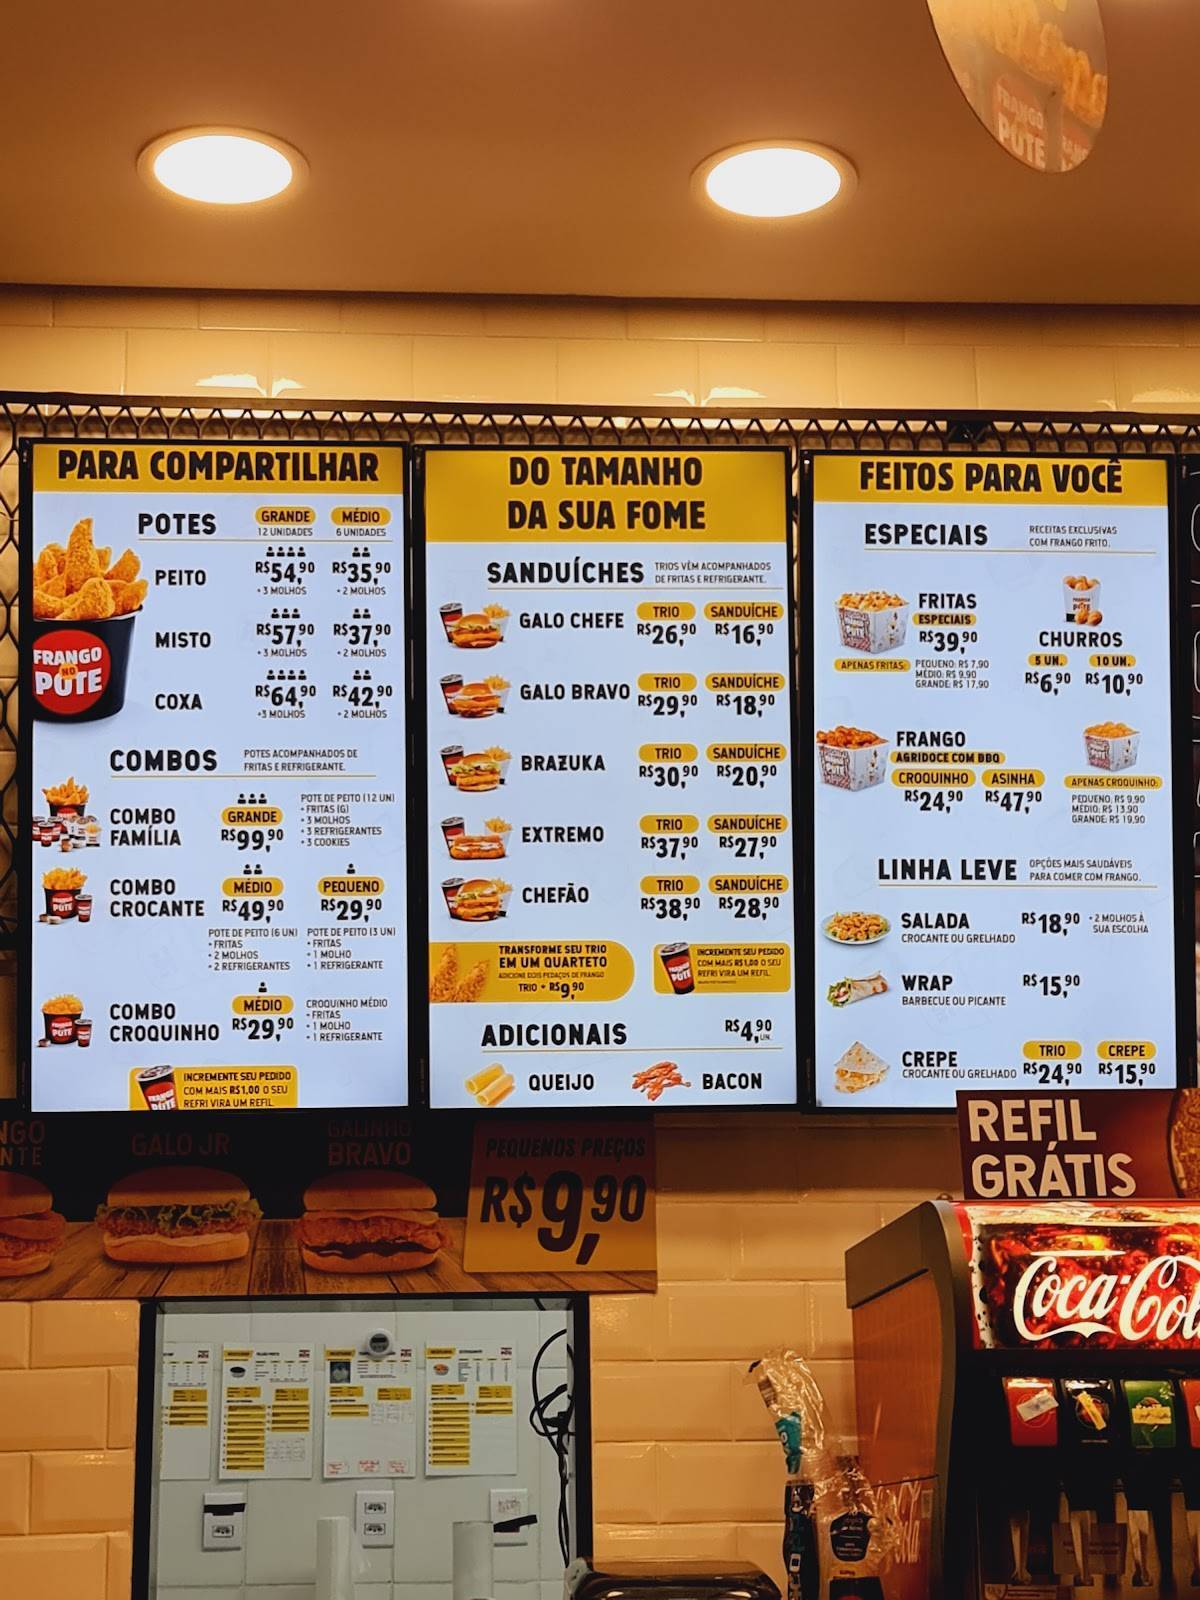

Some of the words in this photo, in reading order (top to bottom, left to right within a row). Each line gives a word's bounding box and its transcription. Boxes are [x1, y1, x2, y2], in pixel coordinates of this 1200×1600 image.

[59, 450, 139, 480] PARA
[150, 451, 378, 481] COMPARTILHAR
[510, 457, 549, 485] DO
[562, 457, 702, 486] TAMANHO
[860, 462, 953, 491] FEITOS
[965, 463, 1042, 492] PARA
[1052, 457, 1123, 493] VOCÊ
[262, 511, 310, 522] GRANDE
[342, 508, 380, 523] MÉDIO
[508, 501, 547, 529] DA
[559, 500, 615, 529] SUA
[627, 501, 705, 529] FOME
[139, 514, 216, 534] POTES
[258, 528, 268, 536] 12
[270, 528, 312, 536] UNIDADES
[336, 528, 342, 536] 6
[344, 528, 386, 536] UNIDADES
[1030, 526, 1066, 534] RECEITAS
[1068, 526, 1117, 534] EXCLUSIVAS
[866, 524, 987, 546] ESPECIAIS
[487, 556, 644, 583] SANDUÍCHES
[655, 562, 679, 570] TRIOS
[701, 562, 771, 570] ACOMPANHADOS
[156, 570, 206, 585] PEITO
[256, 561, 314, 588] R$54,90
[332, 562, 390, 588] R$35,90
[919, 594, 976, 609] FRITAS
[653, 606, 679, 617] TRIO
[711, 603, 778, 617] SANDUÍCHE
[520, 613, 564, 628] GALO
[571, 613, 624, 628] CHEFE
[918, 614, 971, 624] ESPECIAIS
[156, 632, 210, 648] MISTO
[257, 623, 314, 647] R$57,90
[334, 624, 390, 647] R$37,90
[637, 623, 696, 646] R$26,90
[716, 623, 773, 646] R$16,90
[920, 630, 977, 654] R$39,90
[1040, 632, 1122, 647] CHURROS
[33, 647, 102, 666] FRANGO
[1035, 656, 1041, 665] 5
[1044, 656, 1063, 666] UN.
[1096, 656, 1109, 666] 10
[1112, 656, 1130, 666] UN.
[62, 666, 76, 677] NO
[35, 669, 102, 696] POTE
[654, 677, 680, 688] TRIO
[712, 674, 779, 688] SANDUÍCHE
[1026, 672, 1070, 695] R$6,90
[1086, 672, 1142, 696] R$10,90
[256, 685, 316, 708] R$64,90
[333, 685, 392, 708] R$42,90
[520, 684, 565, 700] GALO
[572, 684, 630, 700] BRAVO
[156, 694, 202, 710] COXA
[638, 694, 697, 718] R$29,90
[717, 694, 774, 717] R$18,90
[897, 731, 965, 747] FRANGO
[244, 750, 270, 758] POTES
[273, 750, 345, 758] ACOMPANHADOS
[655, 748, 681, 759] TRIO
[713, 744, 780, 759] SANDUÍCHE
[896, 752, 949, 762] AGRIDOCE
[952, 752, 974, 763] COM
[110, 750, 217, 771] COMBOS
[244, 763, 272, 771] FRITAS
[522, 755, 605, 771] BRAZUKA
[640, 765, 698, 788] R$30,90
[717, 765, 776, 788] R$20,90
[899, 772, 968, 784] CROQUINHO
[992, 773, 1035, 784] ASINHA
[905, 790, 962, 813] R$24,90
[986, 790, 1042, 814] R$47,90
[110, 808, 175, 824] COMBO
[228, 811, 276, 822] GRANDE
[714, 815, 781, 830] SANDUÍCHE
[656, 819, 682, 830] TRIO
[111, 826, 181, 846] FAMÍLIA
[222, 829, 283, 852] R$99,90
[314, 838, 350, 846] COOKIES
[522, 826, 604, 842] EXTREMO
[642, 836, 698, 860] R$37,90
[720, 836, 776, 859] R$27,90
[879, 859, 951, 880] LINHA
[962, 859, 1016, 880] LEVE
[1030, 872, 1051, 880] PARA
[1054, 872, 1082, 880] COMER
[110, 879, 175, 895] COMBO
[234, 879, 272, 893] MÉDIO
[324, 880, 379, 892] PEQUENO
[656, 880, 683, 891] TRIO
[715, 876, 782, 890] SANDUÍCHE
[522, 883, 588, 903] CHEFÃO
[110, 900, 204, 917] CROCANTE
[223, 899, 284, 923] R$49,90
[321, 898, 382, 922] R$29,90
[641, 897, 700, 921] R$38,90
[719, 896, 779, 920] R$28,90
[902, 913, 969, 928] SALADA
[1022, 912, 1080, 936] R$18,90
[1093, 925, 1110, 933] SUA
[1112, 925, 1148, 933] ESCOLHA
[902, 934, 948, 943] CROCANTE
[951, 934, 964, 943] OU
[966, 934, 1015, 943] GRELHADO
[499, 945, 562, 954] TRANSFORME
[565, 945, 582, 954] SEU
[585, 945, 606, 954] TRIO
[500, 957, 516, 968] EM
[521, 957, 540, 968] UM
[544, 956, 607, 968] QUARTETO
[518, 984, 537, 992] TRIO
[902, 975, 952, 990] WRAP
[1024, 974, 1080, 998] R$15,90
[244, 996, 282, 1011] MÉDIO
[902, 996, 950, 1006] BARBECUE
[952, 996, 965, 1006] OU
[968, 996, 1006, 1006] PICANTE
[110, 1004, 175, 1020] COMBO
[110, 1024, 219, 1042] CROQUINHO
[232, 1018, 293, 1042] R$29,90
[481, 1023, 626, 1046] ADICIONAIS
[725, 1019, 772, 1044] R$4,90
[1039, 1045, 1065, 1056] TRIO
[1109, 1045, 1145, 1056] CREPE
[902, 1051, 957, 1067] CREPE
[184, 1072, 238, 1081] INCREMENTE
[240, 1072, 256, 1080] SEU
[259, 1072, 291, 1080] PEDIDO
[703, 1073, 762, 1089] BACON
[902, 1069, 950, 1078] CROCANTE
[952, 1069, 965, 1078] OU
[968, 1069, 1016, 1078] GRELHADO
[1024, 1062, 1082, 1086] R$24,90
[1099, 1062, 1155, 1086] R$15,90
[529, 1074, 594, 1091] QUEIJO
[968, 1099, 1096, 1143] REFIL
[131, 1133, 192, 1156] GALO
[200, 1132, 231, 1156] JR
[486, 1138, 575, 1159] PEQUENOS
[581, 1138, 646, 1163] PREÇOS
[328, 1142, 411, 1166] BRAVO
[971, 1140, 1136, 1198] GRÁTIS
[1013, 1250, 1200, 1341] Coca-Col
